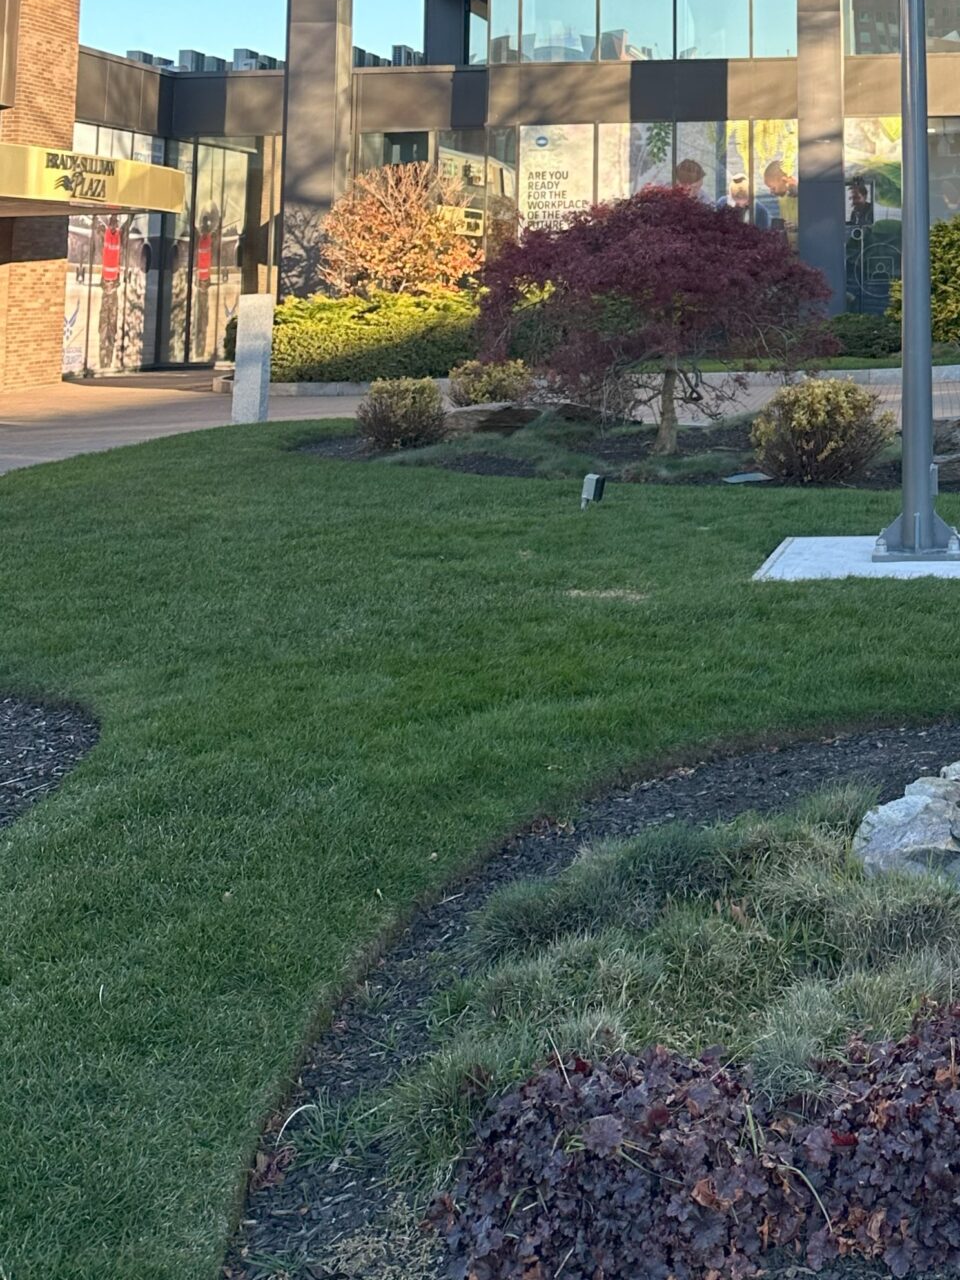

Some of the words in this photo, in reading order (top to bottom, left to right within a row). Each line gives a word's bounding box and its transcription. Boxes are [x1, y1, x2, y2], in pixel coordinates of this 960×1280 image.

[528, 171, 547, 180] ARE
[549, 170, 569, 180] YOU
[70, 171, 106, 198] PLAZA
[528, 181, 560, 190] READY
[528, 191, 546, 200] FOR
[549, 190, 567, 199] THE
[527, 200, 588, 210] WORKPLACE
[527, 211, 539, 220] OF
[542, 210, 560, 219] THE
